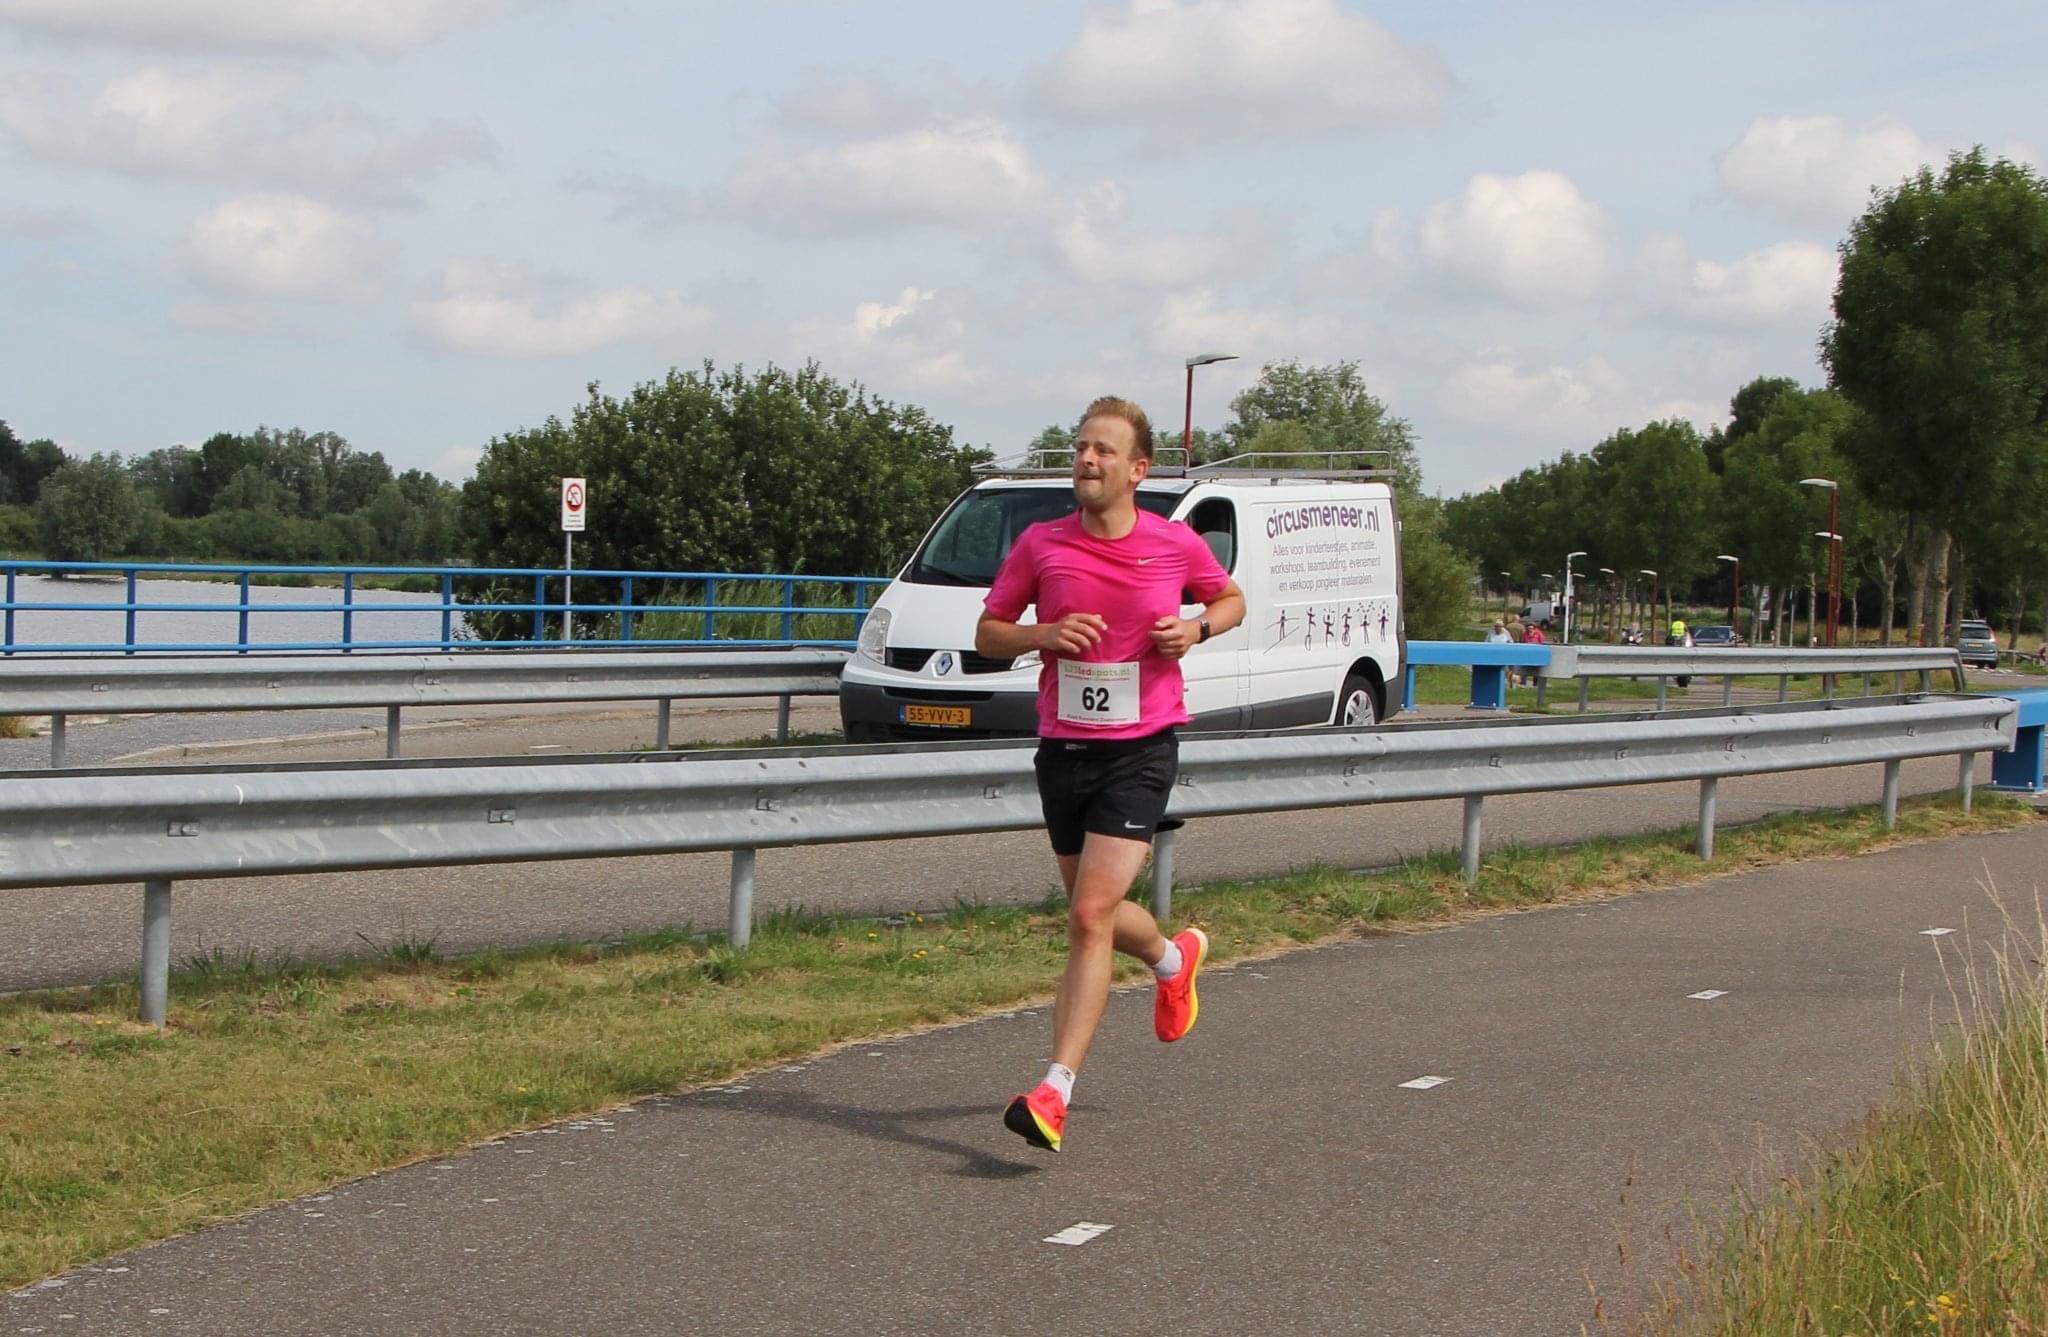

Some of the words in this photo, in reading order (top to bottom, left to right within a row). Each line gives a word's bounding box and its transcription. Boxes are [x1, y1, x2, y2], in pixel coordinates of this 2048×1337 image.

[1266, 505, 1380, 539] circusmeneer.nl
[1273, 544, 1289, 556] Alles
[1291, 545, 1304, 555] voor
[1279, 582, 1288, 591] en
[1289, 578, 1314, 591] verkoop
[1315, 577, 1340, 591] jongleer
[1082, 686, 1110, 712] 62
[908, 707, 964, 723] 55-VVV-3
